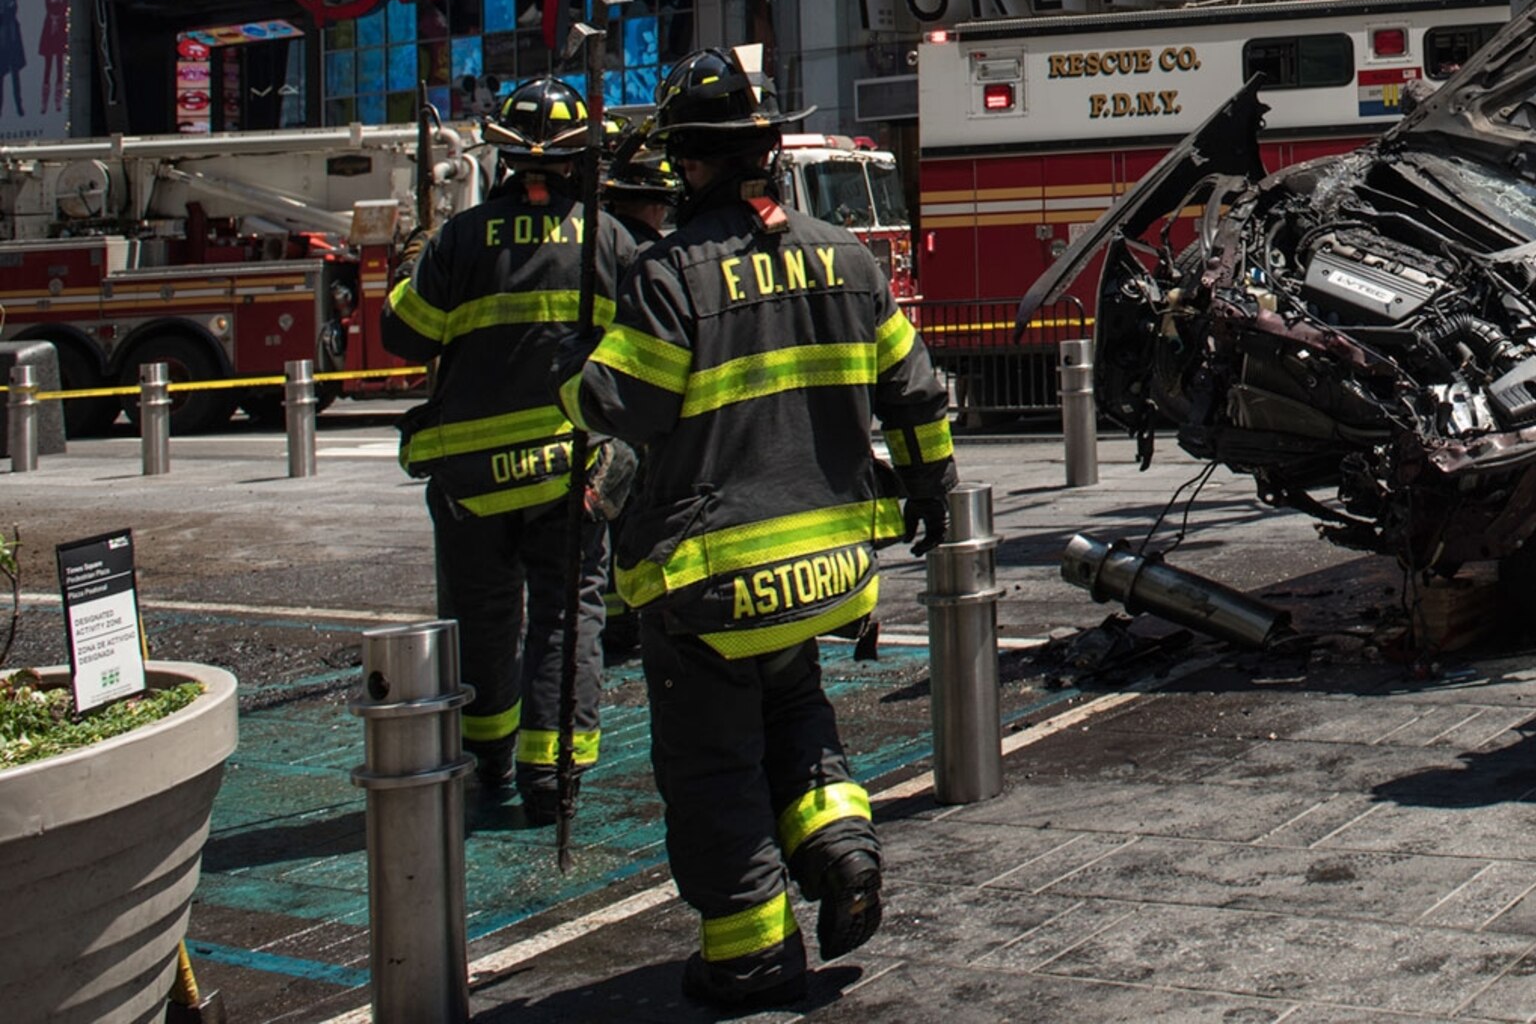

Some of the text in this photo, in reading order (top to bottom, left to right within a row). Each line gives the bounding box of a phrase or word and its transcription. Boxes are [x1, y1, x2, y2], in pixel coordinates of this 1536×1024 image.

[1048, 46, 1202, 78] RESCUE CO.
[1089, 90, 1182, 118] F.D.N.Y.
[721, 247, 844, 302] F.D.N.Y.
[491, 440, 573, 484] DUFFY
[733, 546, 870, 620] ASTORINA
